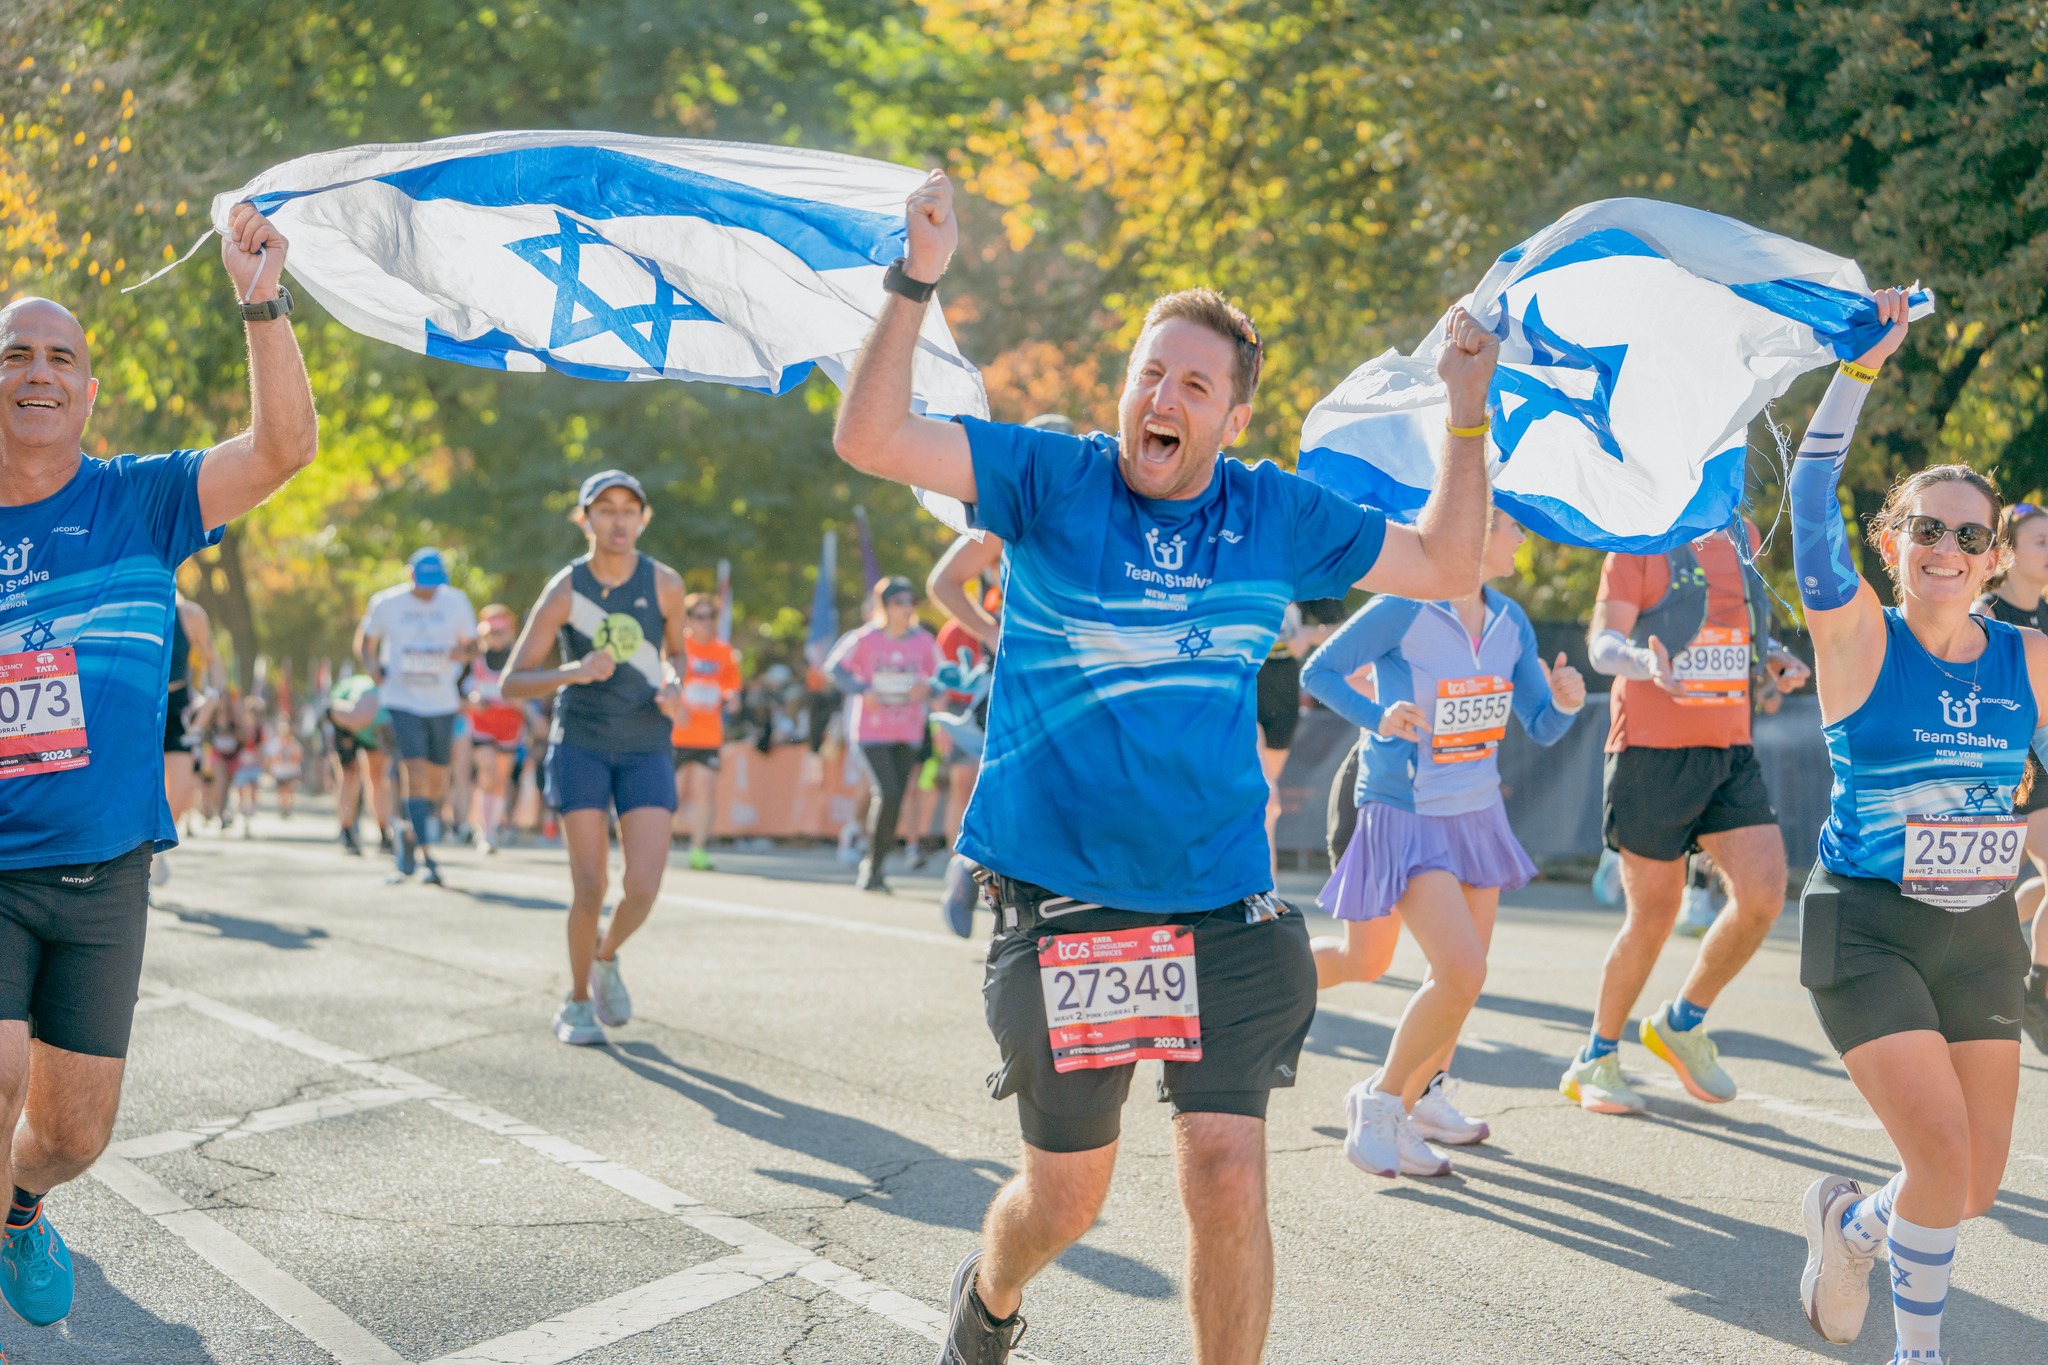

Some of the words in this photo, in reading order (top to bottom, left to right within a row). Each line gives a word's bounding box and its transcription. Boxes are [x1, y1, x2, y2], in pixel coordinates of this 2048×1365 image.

[51, 525, 81, 534] ucony
[1145, 588, 1167, 601] NEW
[1678, 648, 1746, 671] 39869
[35, 664, 59, 674] TATA
[0, 680, 71, 724] 073
[1982, 697, 2014, 707] saucony
[1442, 695, 1508, 726] 35555
[20, 723, 27, 732] F
[1956, 731, 2008, 750] Shalva
[41, 750, 73, 762] 2024
[1935, 749, 1957, 757] NEW
[1958, 751, 1983, 760] YORK
[1933, 758, 1984, 769] MARATHON
[1994, 814, 2015, 822] TATA
[1915, 829, 2019, 866] 25789
[1927, 867, 1934, 875] 2
[1975, 866, 1982, 875] F
[1092, 936, 1113, 944] TATA
[1092, 940, 1138, 951] CONSULTANCY
[1057, 940, 1090, 960] tcs
[1092, 949, 1123, 957] SERVICES
[1149, 944, 1175, 953] TATA
[1054, 962, 1186, 1011] 27349
[1075, 1011, 1083, 1021] 2
[1103, 1007, 1132, 1018] CORRAL
[1133, 1005, 1140, 1014] F
[1153, 1037, 1186, 1049] 2024
